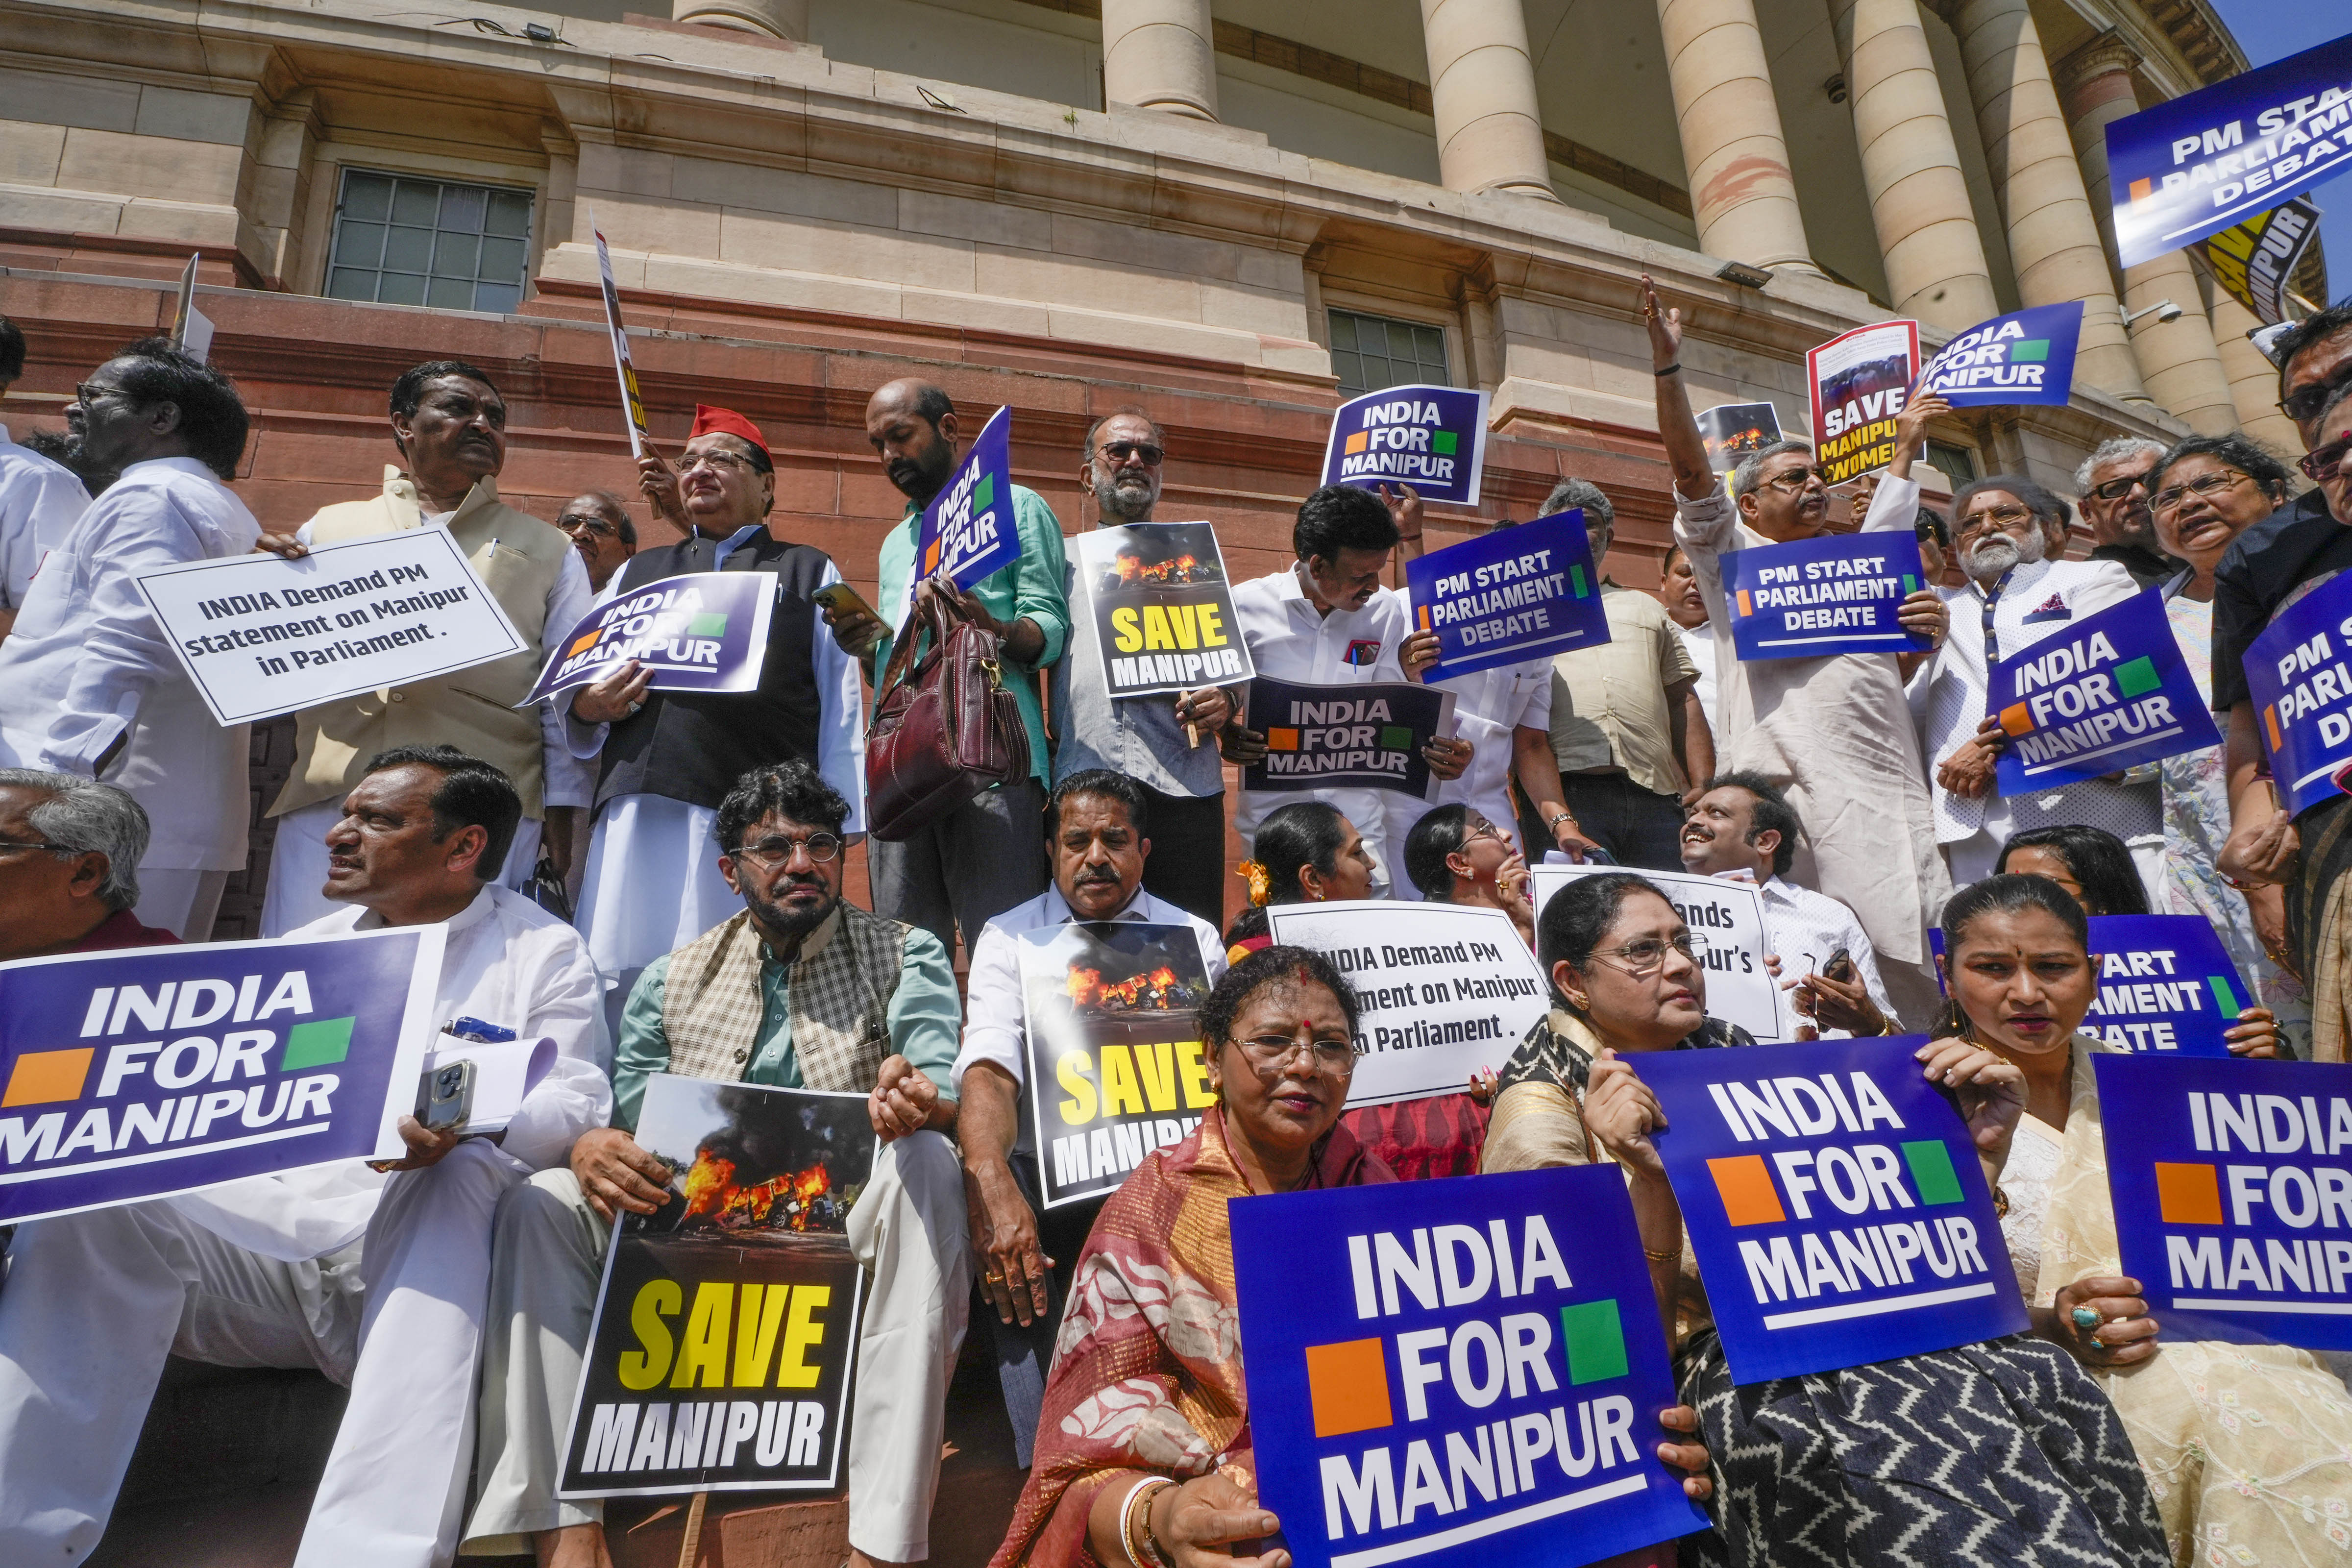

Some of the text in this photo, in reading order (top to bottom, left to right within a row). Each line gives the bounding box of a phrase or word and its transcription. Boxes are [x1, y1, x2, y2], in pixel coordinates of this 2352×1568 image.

[2162, 99, 2352, 194] PARLIAM
[2172, 82, 2352, 165] PM STA
[1913, 365, 2045, 399] ANIPUR
[1925, 344, 2006, 384] FOR
[1363, 401, 1442, 428] INDIA
[1825, 387, 1905, 437] SAVE
[1370, 427, 1430, 452] FOR
[1820, 418, 1897, 462] MANIPU
[1341, 453, 1455, 479] MANIPUR
[937, 454, 980, 534] INDIA
[940, 495, 971, 560] FOR
[197, 564, 430, 621] INDIA Demand PM
[1435, 549, 1551, 599] PM START
[1755, 578, 1897, 609] PARLIAMENT
[1758, 557, 1886, 585] PM START
[184, 585, 471, 657] statement on Manipur
[598, 588, 704, 628] INDIA
[1432, 572, 1565, 627] PARLIAMENT
[1784, 606, 1876, 631] DEBATE
[598, 612, 686, 644] FOR
[1111, 603, 1227, 653] SAVE
[1460, 608, 1550, 647] DEBATE
[255, 656, 289, 676] in
[555, 637, 721, 679] MANIPUR
[1111, 648, 1243, 686] MANIPUR
[2015, 631, 2119, 697] INDIA
[2278, 632, 2332, 686] PM
[1290, 699, 1392, 725] INDIA
[2030, 673, 2117, 728] FOR
[1303, 725, 1376, 751] FOR
[2015, 696, 2178, 766] MANIPUR
[1267, 751, 1410, 773] MANIPUR
[1674, 902, 1734, 929] ands
[1381, 941, 1468, 967] Demand
[1469, 943, 1503, 962] PM
[2088, 951, 2176, 978] ART
[79, 970, 313, 1038] INDIA
[1421, 983, 1450, 1004] on
[1457, 974, 1538, 1001] Manipur
[96, 1029, 276, 1098] FOR
[1056, 1041, 1219, 1126] SAVE
[0, 1074, 340, 1165] MANIPUR
[1706, 1071, 1906, 1142] INDIA
[1771, 1144, 1915, 1220] FOR
[2226, 1165, 2352, 1228] FOR
[1347, 1214, 1573, 1320] INDIA
[1738, 1216, 1988, 1304] MANIPUR
[618, 1279, 831, 1391] SAVE
[1396, 1312, 1559, 1421] FOR
[581, 1401, 825, 1473] MANIPUR
[1319, 1394, 1640, 1541] MANIPUR
